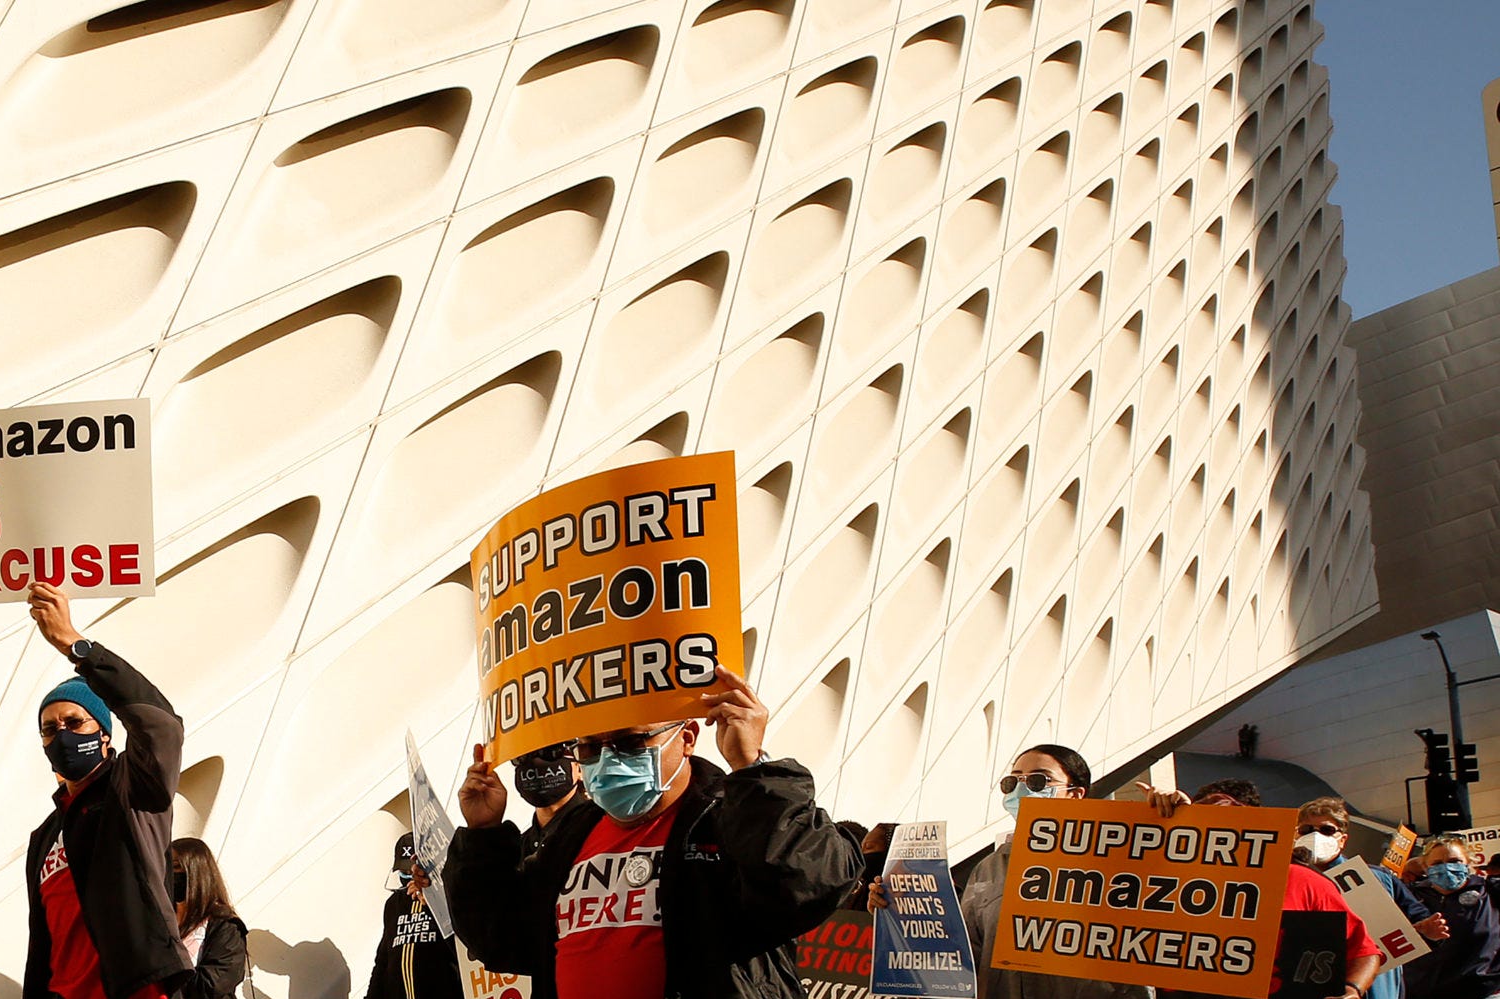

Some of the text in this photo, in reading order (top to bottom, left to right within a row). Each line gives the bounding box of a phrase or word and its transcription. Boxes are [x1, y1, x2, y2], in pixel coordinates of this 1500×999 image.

[478, 483, 716, 614] SUPPORT
[480, 557, 711, 679] amazon
[482, 633, 719, 747] WORKERS
[520, 765, 566, 781] LCLAA
[402, 846, 412, 857] X
[1027, 818, 1278, 868] SUPPORT
[890, 873, 938, 892] DEFEND
[1019, 865, 1260, 921] amazon
[894, 895, 945, 916] WHAT'S
[392, 932, 437, 948] MATTER
[397, 921, 430, 935] LIVES
[900, 920, 949, 939] YOURS.
[1012, 915, 1256, 974] WORKERS
[797, 946, 873, 976] STING
[888, 950, 963, 971] MOBILIZE!
[1293, 950, 1337, 984] IS
